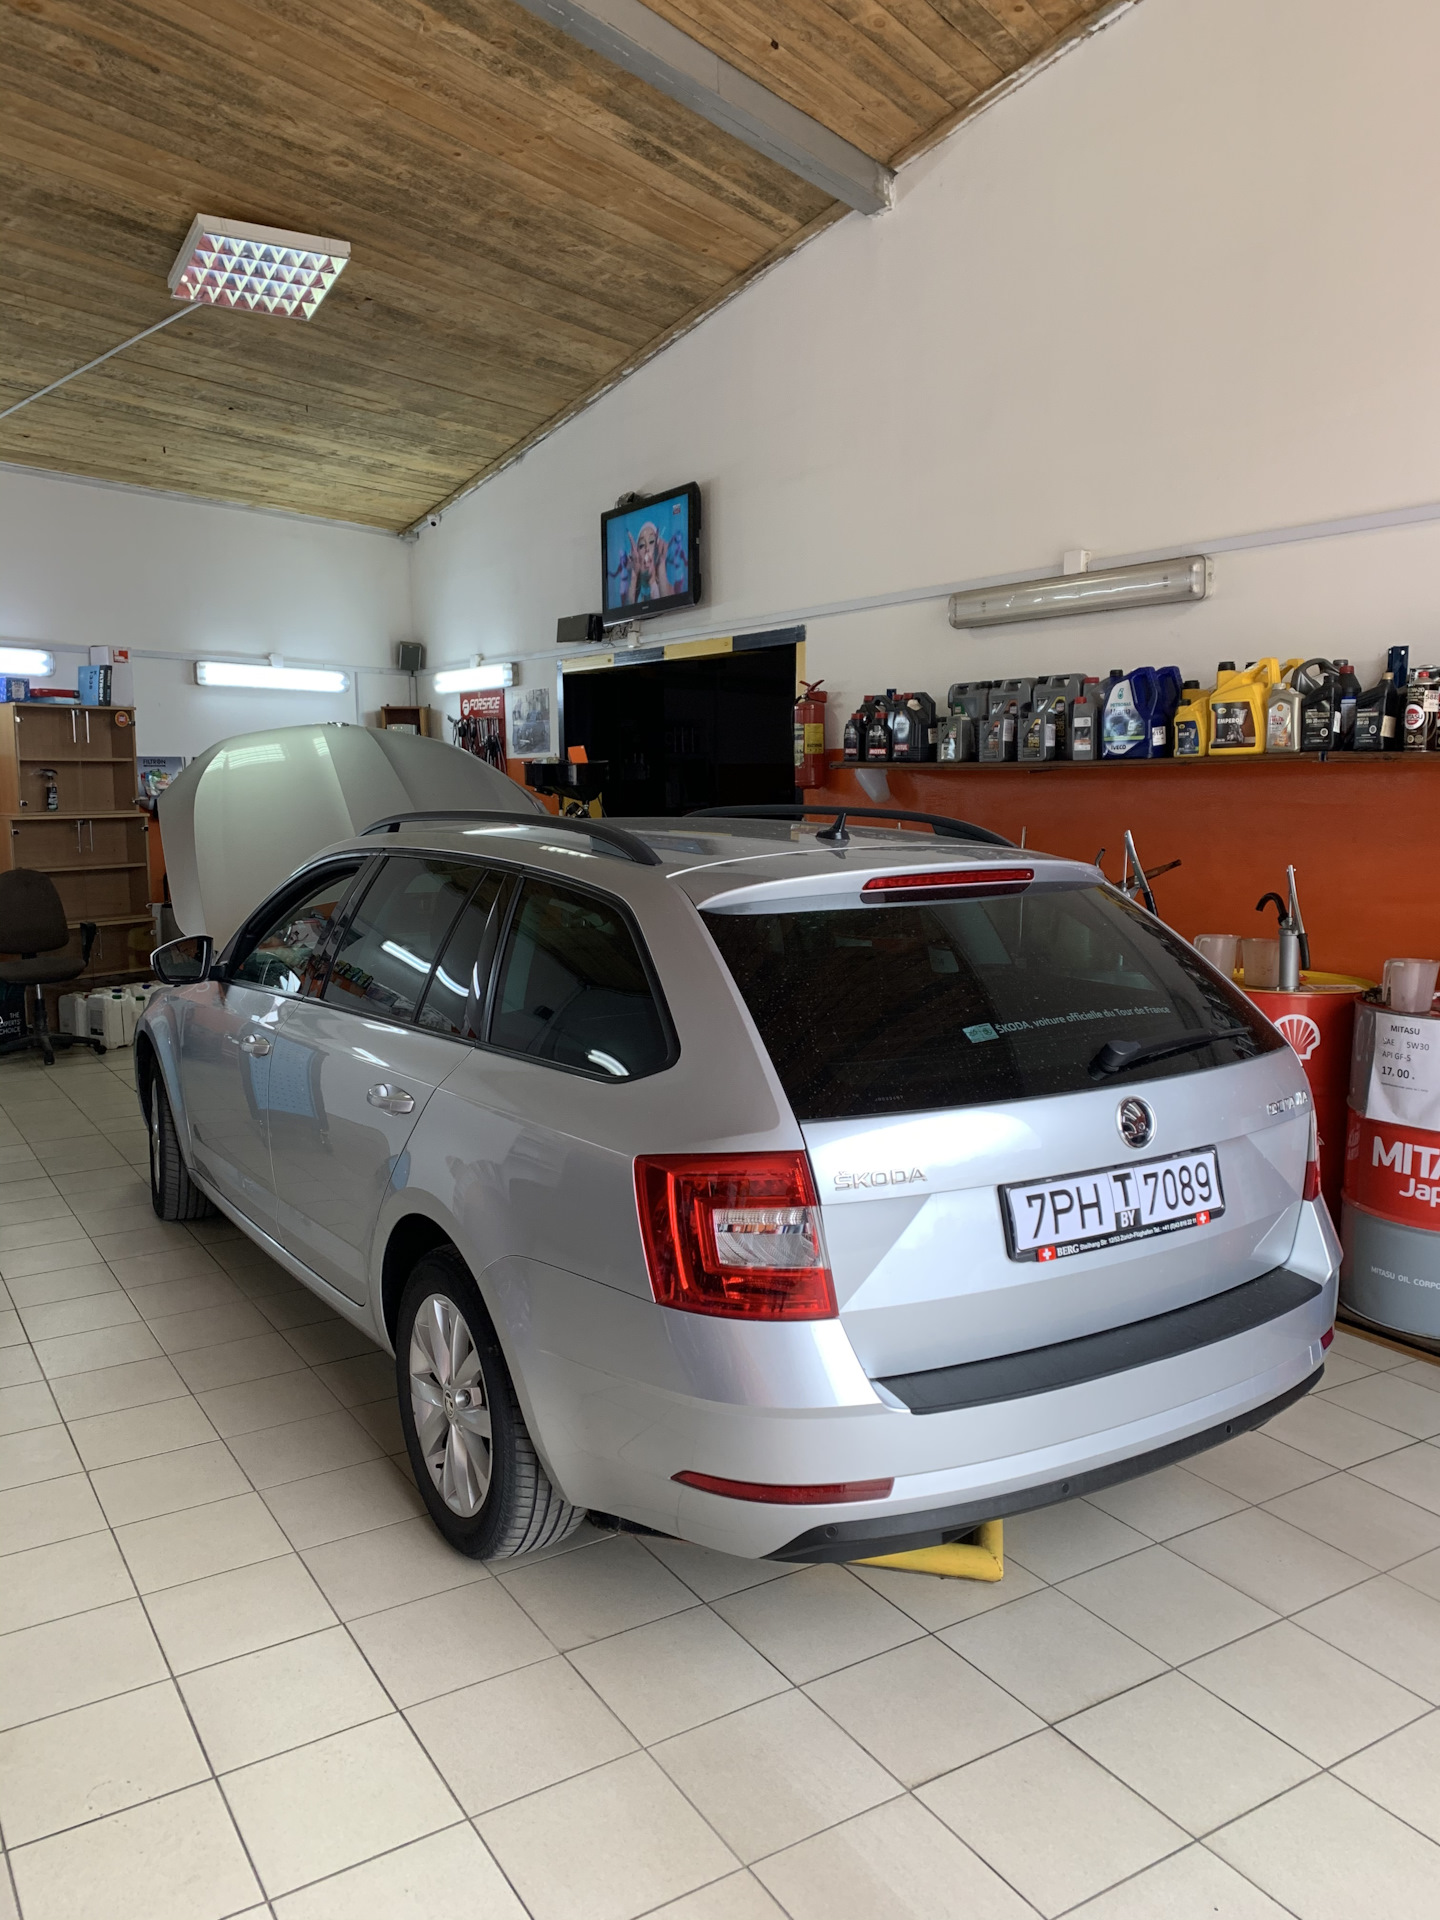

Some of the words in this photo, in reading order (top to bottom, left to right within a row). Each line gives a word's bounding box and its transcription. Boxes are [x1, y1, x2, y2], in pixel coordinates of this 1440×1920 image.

[470, 697, 500, 710] FORSAGE
[1032, 1015, 1066, 1027] voiture
[1066, 1010, 1103, 1022] officielle
[1103, 1008, 1115, 1017] du
[1114, 1008, 1134, 1016] Tour
[1134, 1006, 1145, 1014] de
[1143, 1005, 1171, 1014] France
[1390, 1025, 1420, 1035] MITASU
[1382, 1037, 1395, 1046] SAE
[1406, 1041, 1430, 1051] 5W30
[1382, 1050, 1393, 1059] API
[834, 1167, 928, 1191] ŠKODA
[1143, 1161, 1213, 1216] 7089
[1120, 1209, 1136, 1228] BY
[1057, 1243, 1080, 1257] BERG
[1371, 1266, 1395, 1280] MITASU
[1398, 1275, 1410, 1284] OIL
